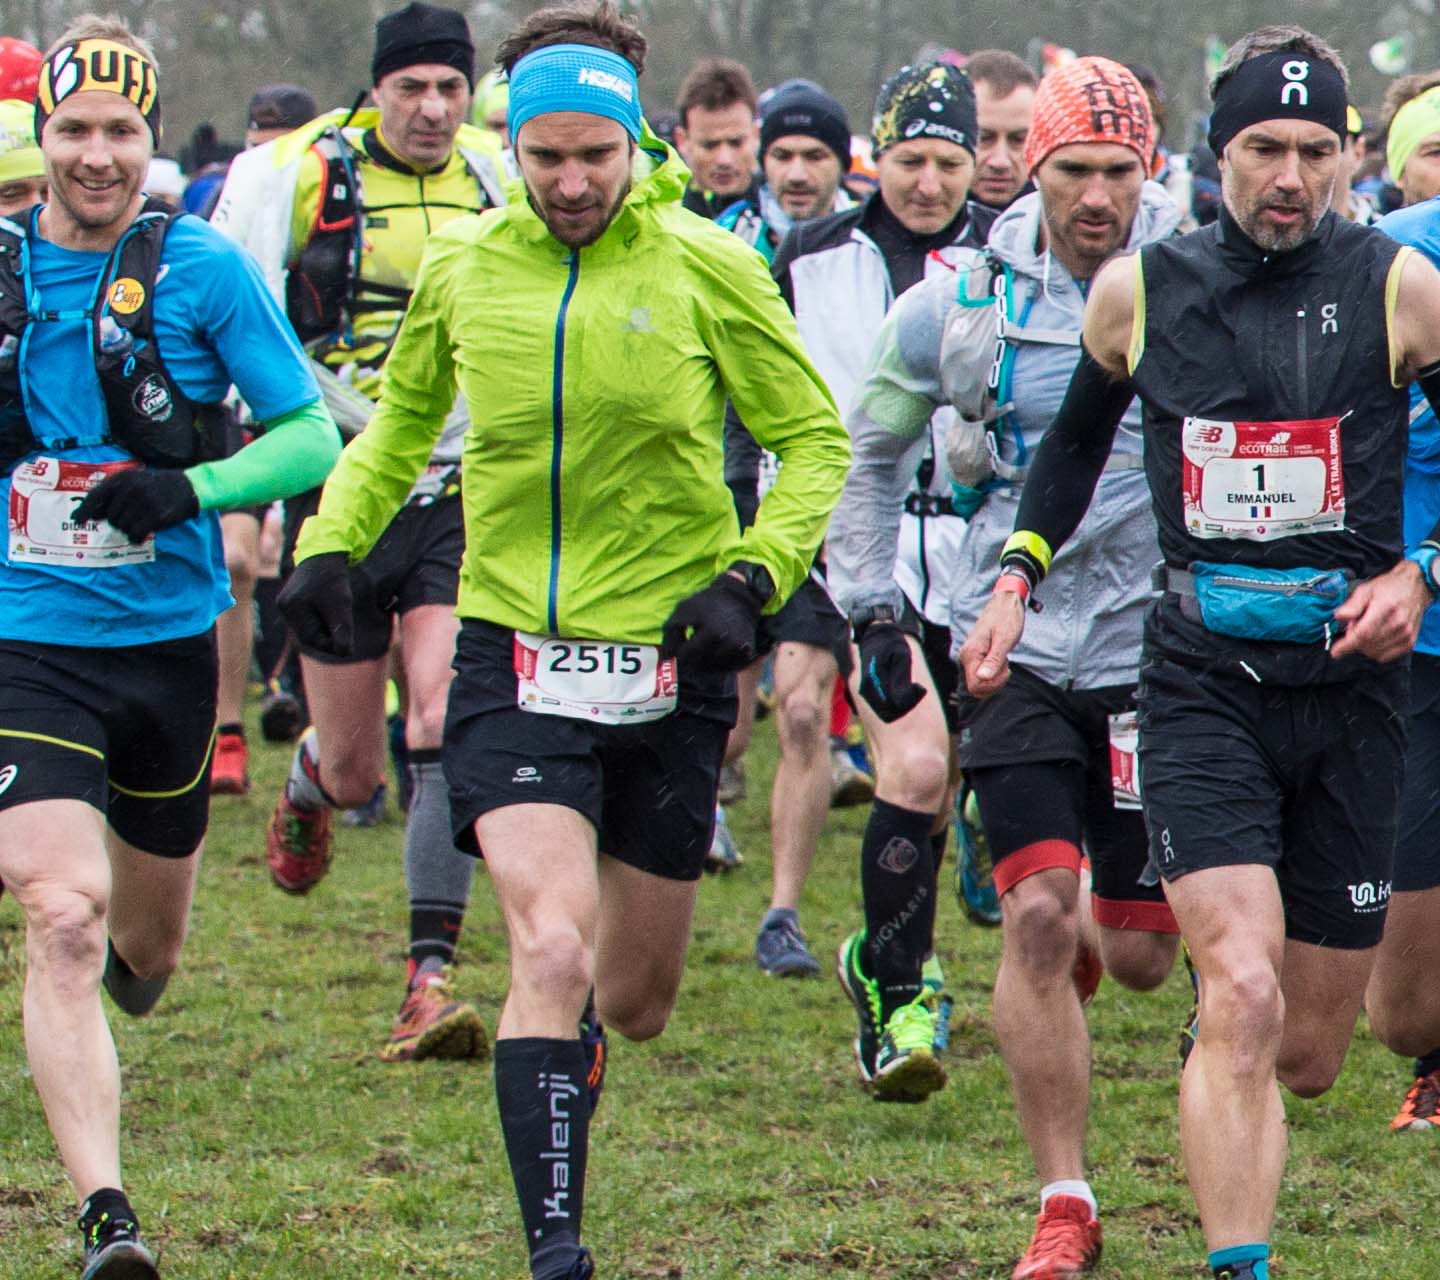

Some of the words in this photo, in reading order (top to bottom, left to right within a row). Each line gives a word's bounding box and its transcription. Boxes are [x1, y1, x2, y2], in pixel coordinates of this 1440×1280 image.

[924, 123, 966, 144] asics
[1252, 464, 1265, 492] 1
[1227, 493, 1296, 504] EMMANUEL
[550, 645, 641, 674] 2515
[871, 886, 928, 954] SIGVARIS
